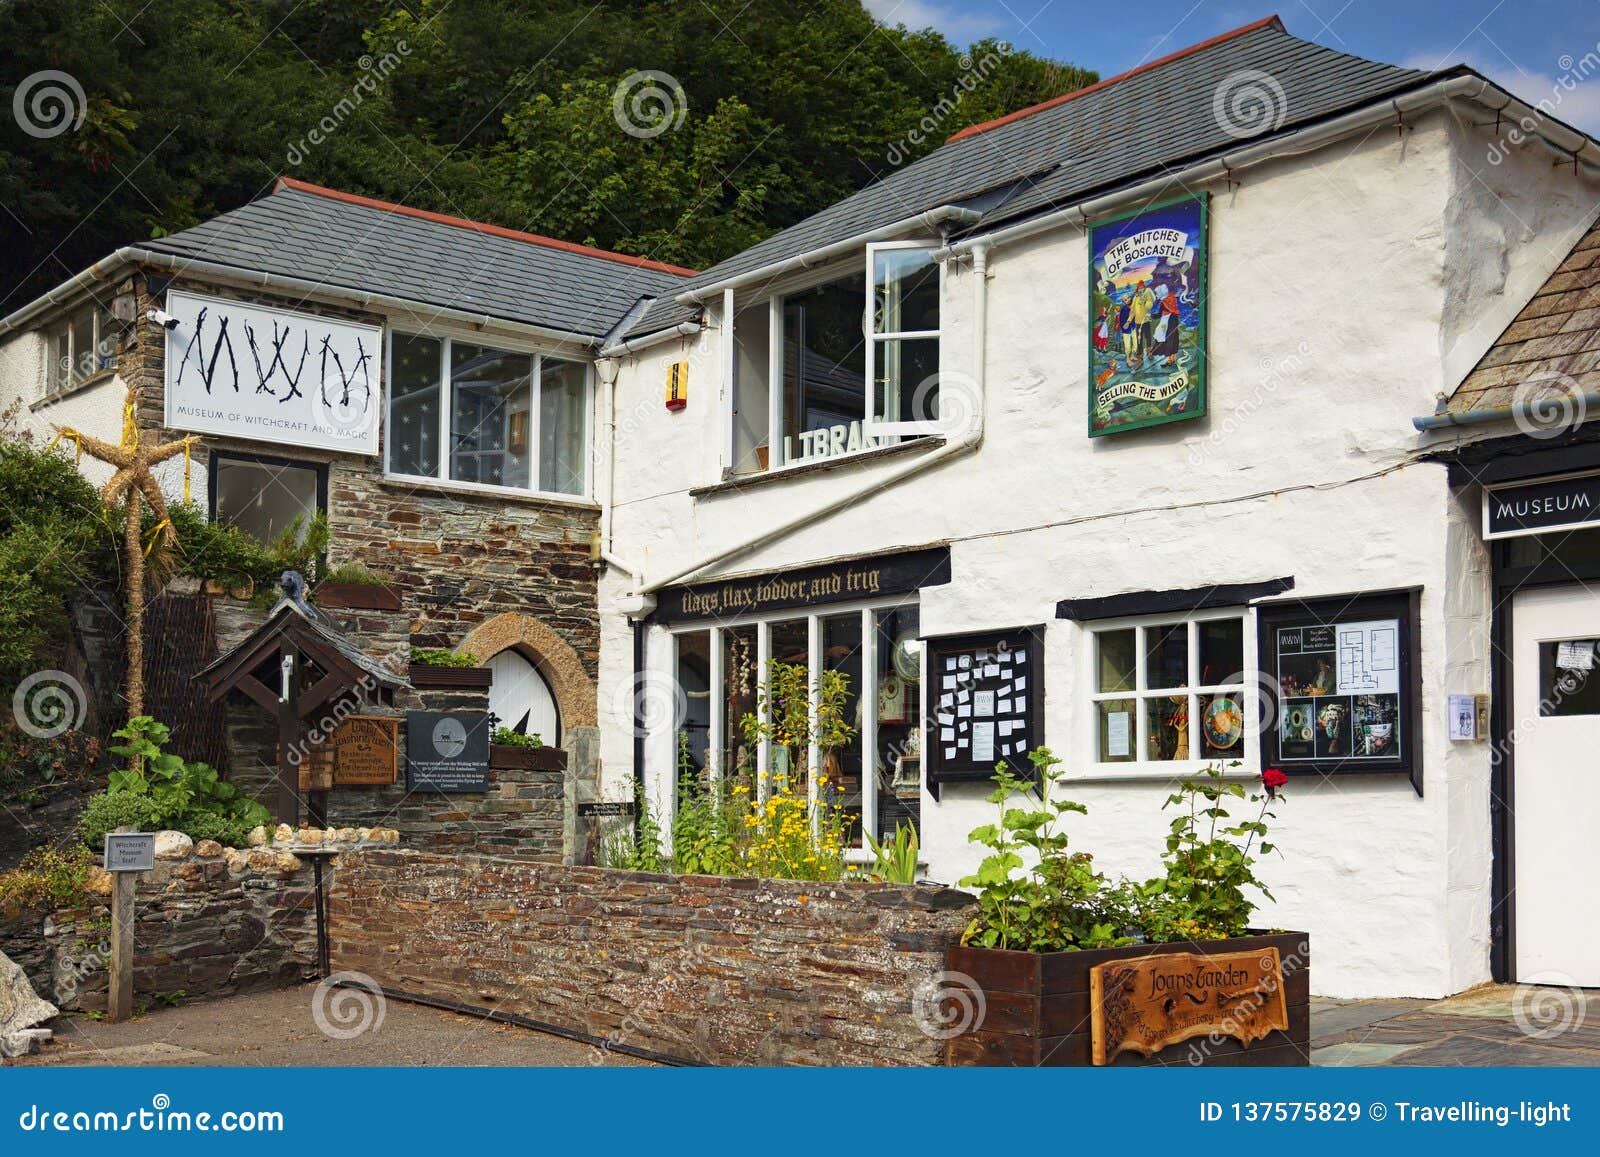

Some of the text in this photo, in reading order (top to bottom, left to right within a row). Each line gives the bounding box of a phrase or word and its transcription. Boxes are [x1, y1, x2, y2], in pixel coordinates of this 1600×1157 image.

[1110, 230, 1179, 259] THE WITCHES
[1108, 245, 1183, 274] OF BOSCASTLE
[1099, 377, 1184, 406] SELLING THE WIND
[177, 406, 369, 440] MUSEUM OF WITCHCRAFT AND MAGIC
[1496, 492, 1591, 520] MUSEUM
[1195, 963, 1249, 989] Garden
